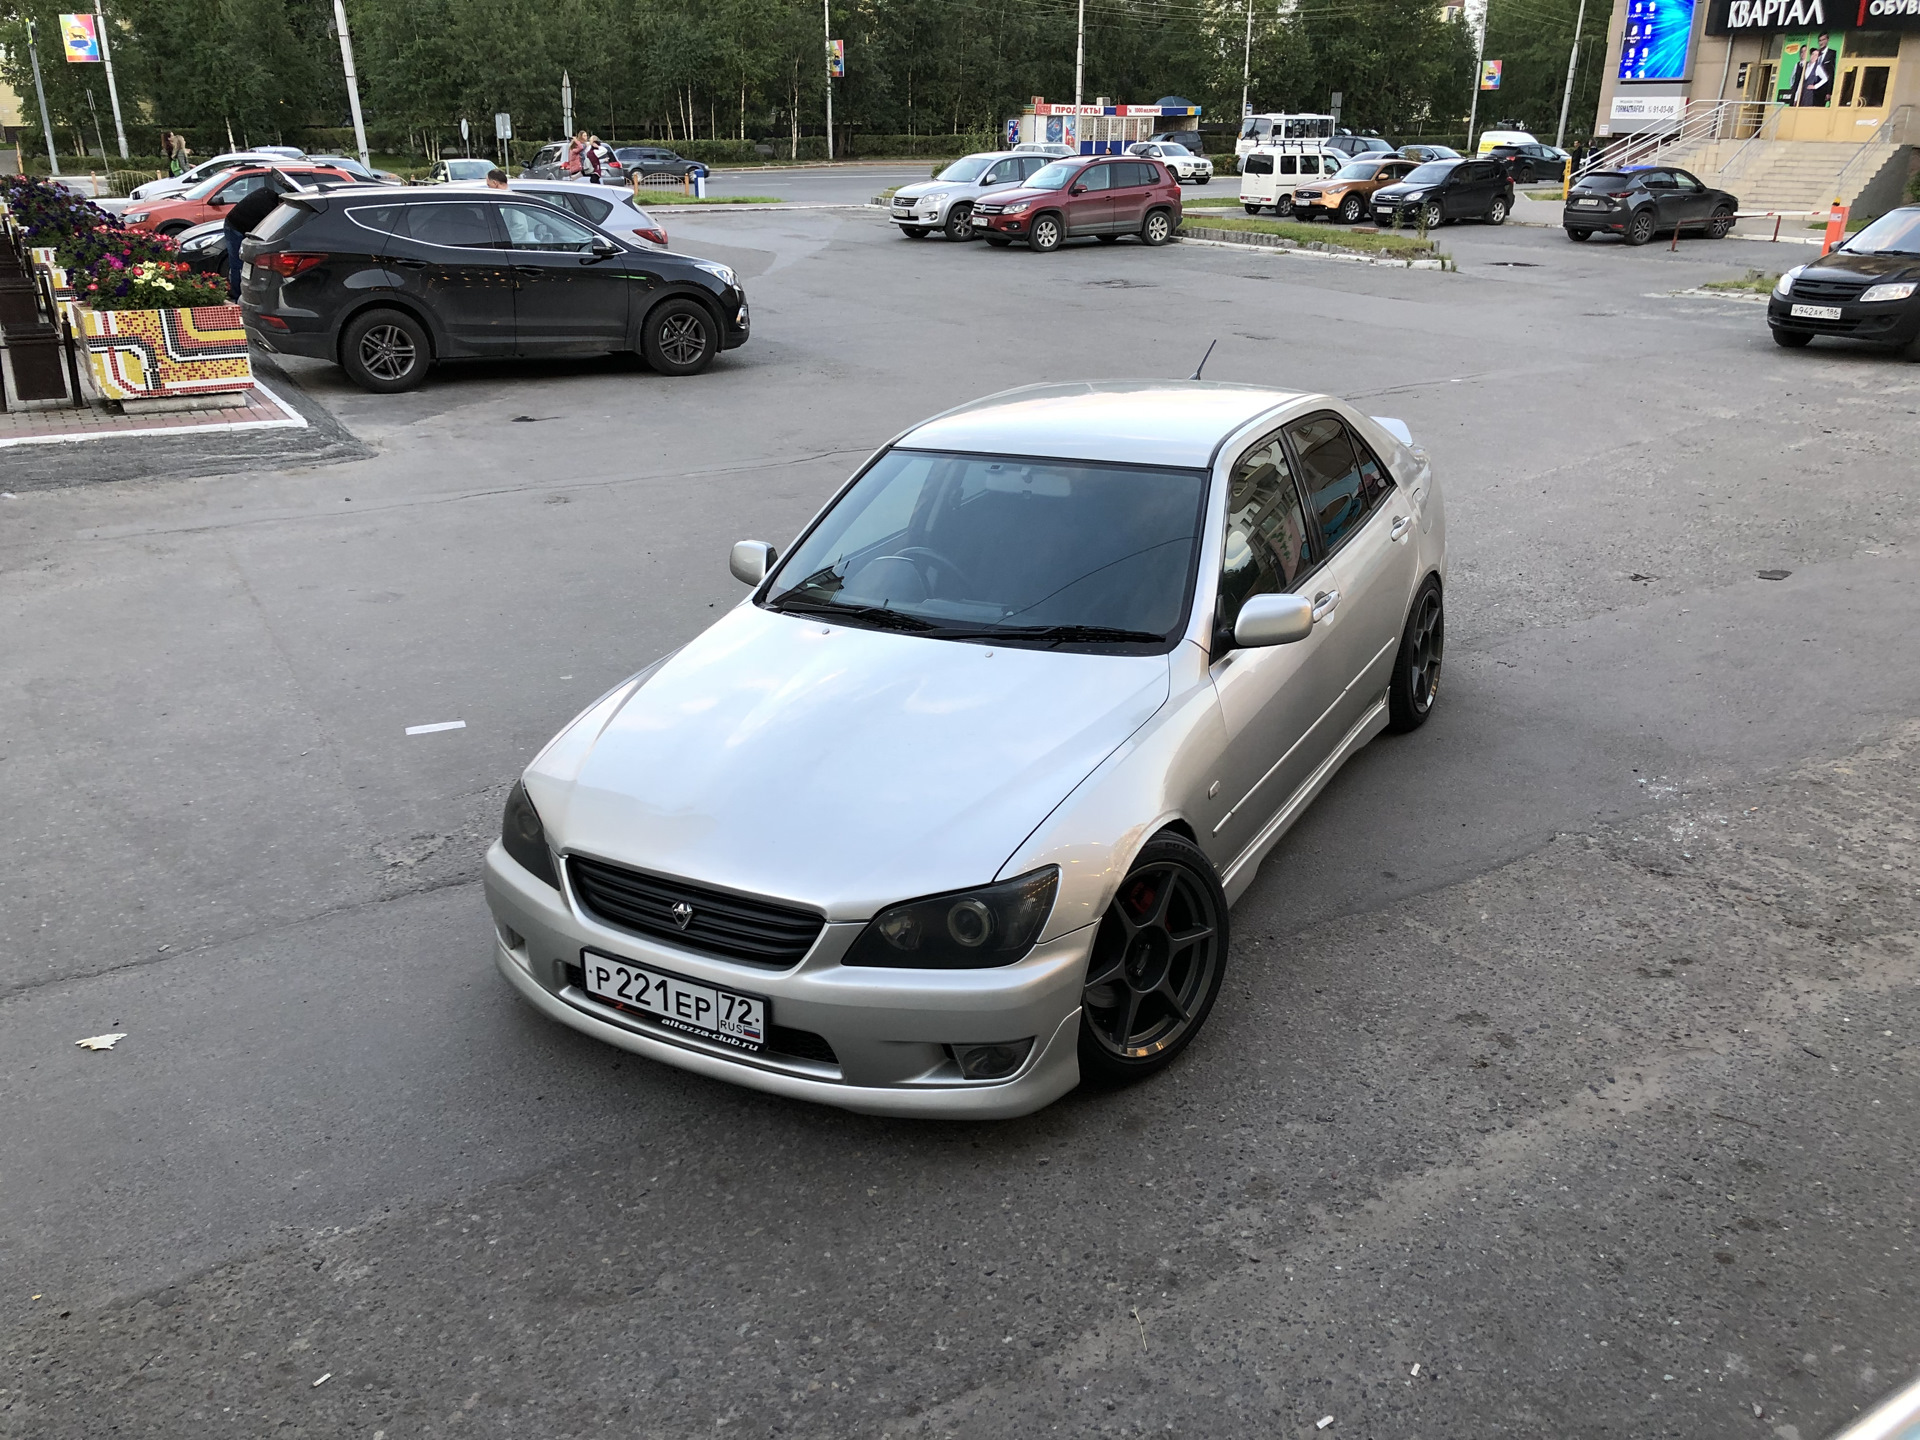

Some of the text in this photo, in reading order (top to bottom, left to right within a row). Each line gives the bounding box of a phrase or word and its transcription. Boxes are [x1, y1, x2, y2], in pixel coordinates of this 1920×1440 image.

[1727, 0, 1824, 28] КВАРТАЛ
[596, 966, 753, 1026] Р221ЕР 72
[661, 1018, 759, 1051] altezza-club.ru
[720, 1019, 743, 1034] RUS
